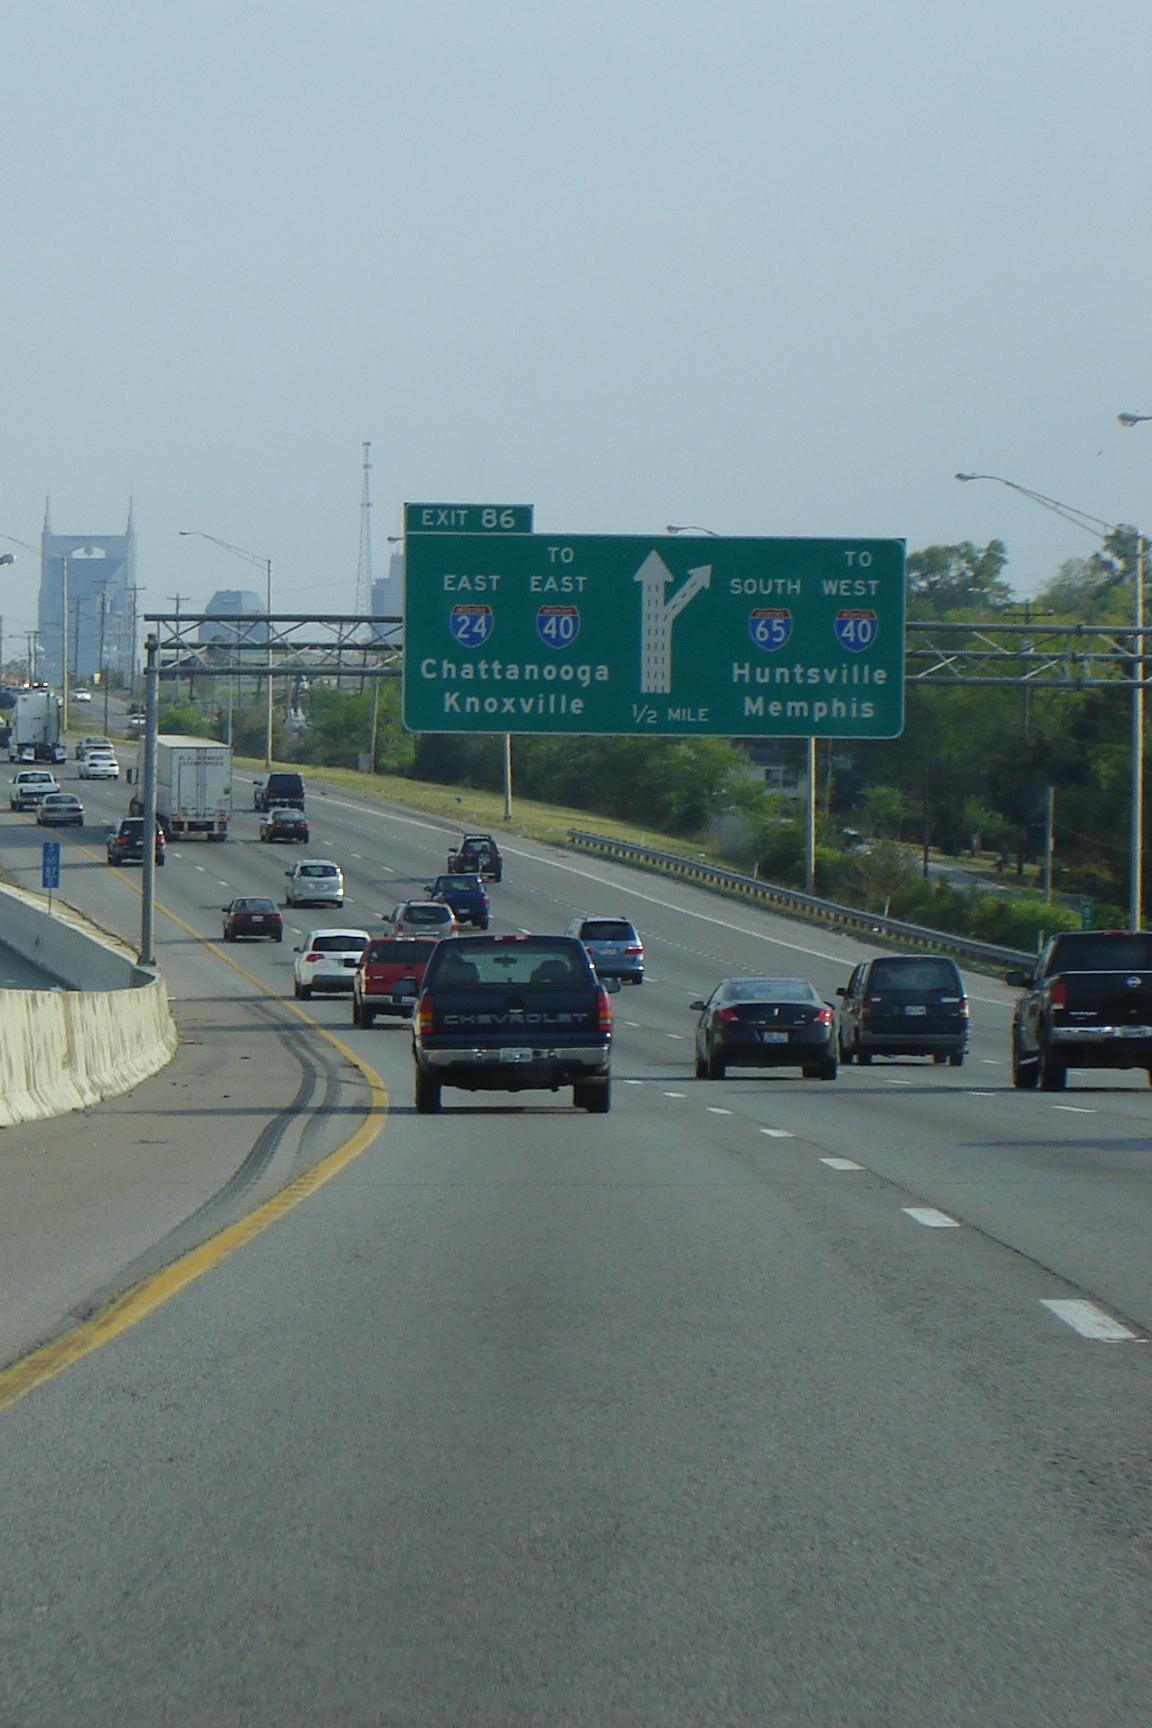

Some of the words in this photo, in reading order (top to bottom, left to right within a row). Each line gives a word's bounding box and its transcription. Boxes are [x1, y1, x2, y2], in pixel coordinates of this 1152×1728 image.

[421, 508, 469, 526] EXIT
[481, 508, 516, 528] 86
[547, 546, 575, 564] TO
[844, 550, 874, 567] TO
[443, 574, 502, 591] EAST
[530, 575, 588, 592] EAST
[730, 578, 802, 595] SOUTH
[822, 579, 880, 596] WEST
[456, 615, 487, 638] 24
[543, 616, 573, 639] 40
[755, 619, 786, 642] 65
[841, 619, 872, 642] 40
[420, 657, 610, 688] Chattanooga
[732, 662, 888, 685] Huntsville
[444, 691, 585, 715] Knoxville
[667, 707, 709, 722] MILE
[744, 696, 876, 721] Memphis
[443, 1013, 588, 1024] CHEVROLET
